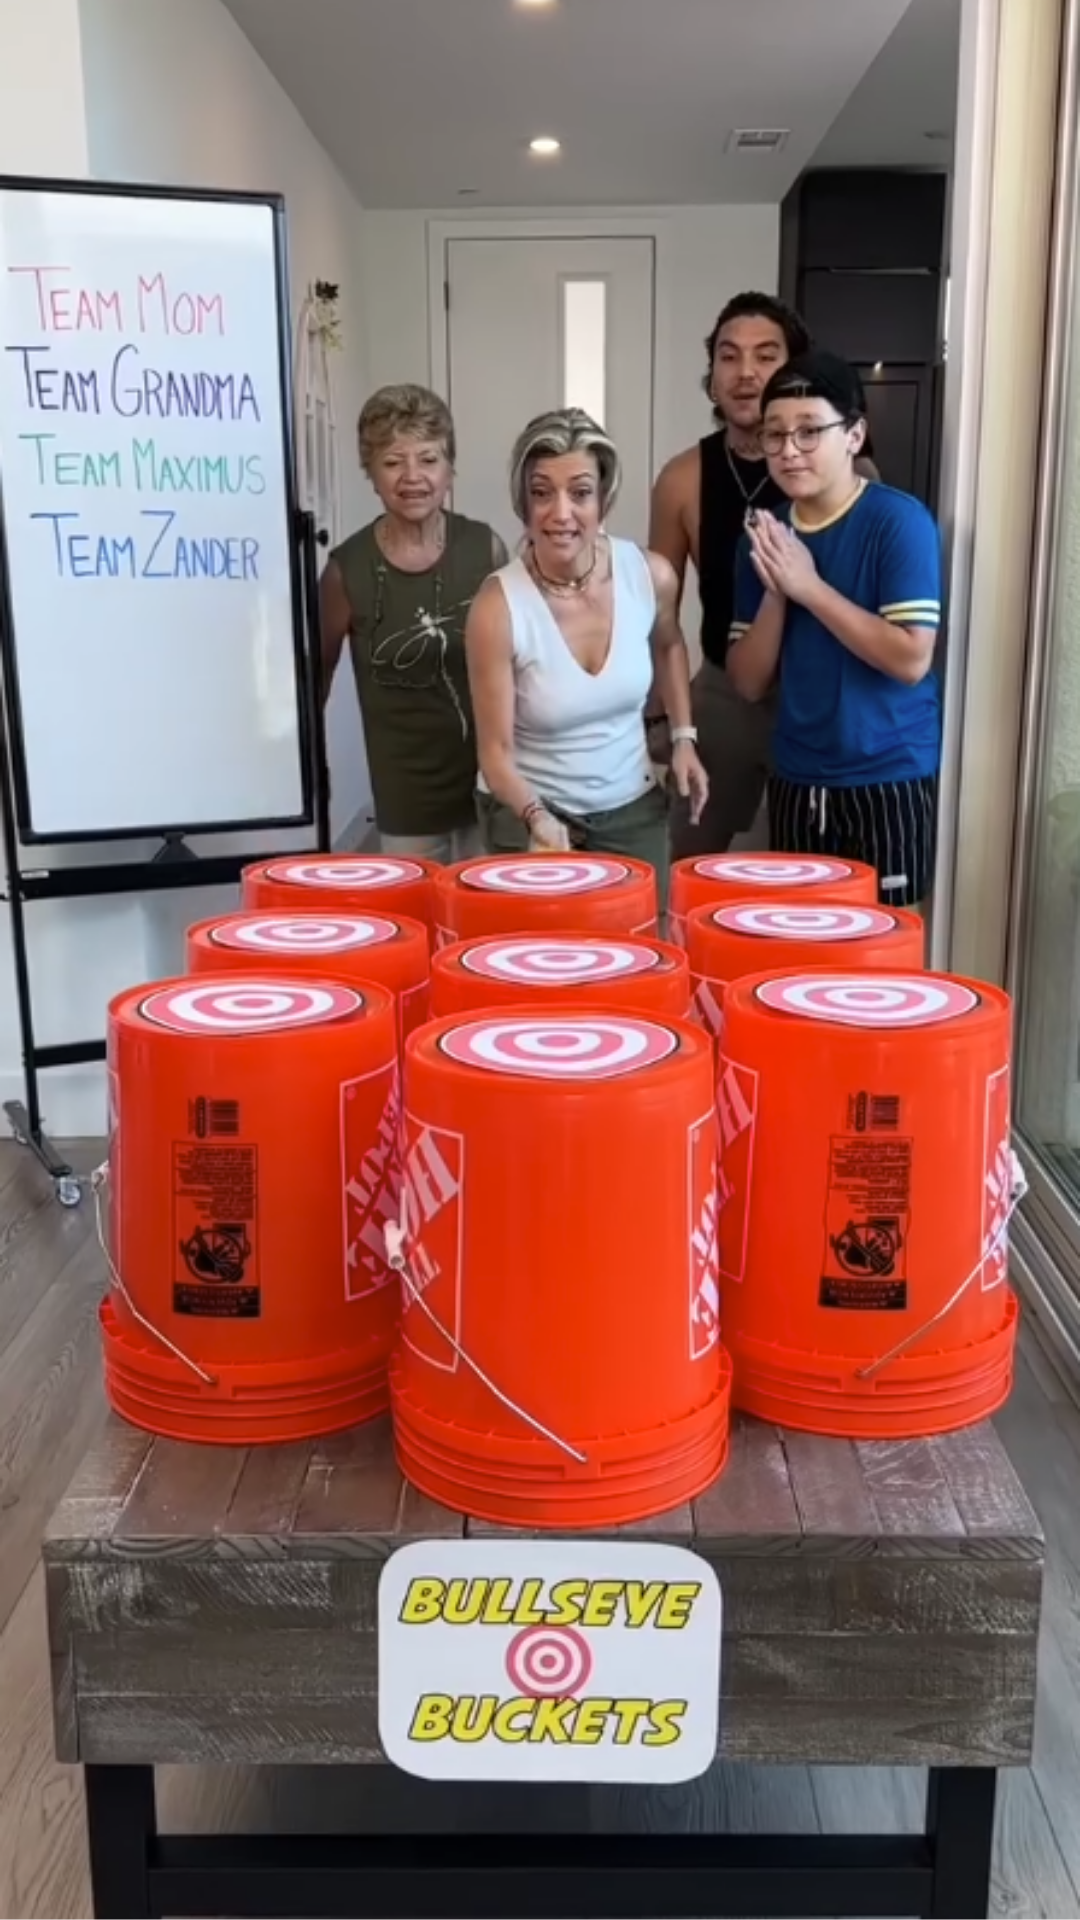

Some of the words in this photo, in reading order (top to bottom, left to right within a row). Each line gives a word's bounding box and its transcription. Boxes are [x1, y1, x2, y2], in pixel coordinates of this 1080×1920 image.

[8, 266, 123, 332] TEAM
[138, 271, 225, 336] MOM
[5, 345, 100, 415] TEAM
[110, 343, 261, 423] GRANDMA
[18, 433, 121, 488] TEAM
[132, 437, 266, 495] MAXIMUS
[29, 513, 135, 579] TEAM
[140, 510, 259, 581] ZANDER
[398, 1576, 702, 1629] BULLSEYE
[408, 1693, 687, 1747] BUCKETS
